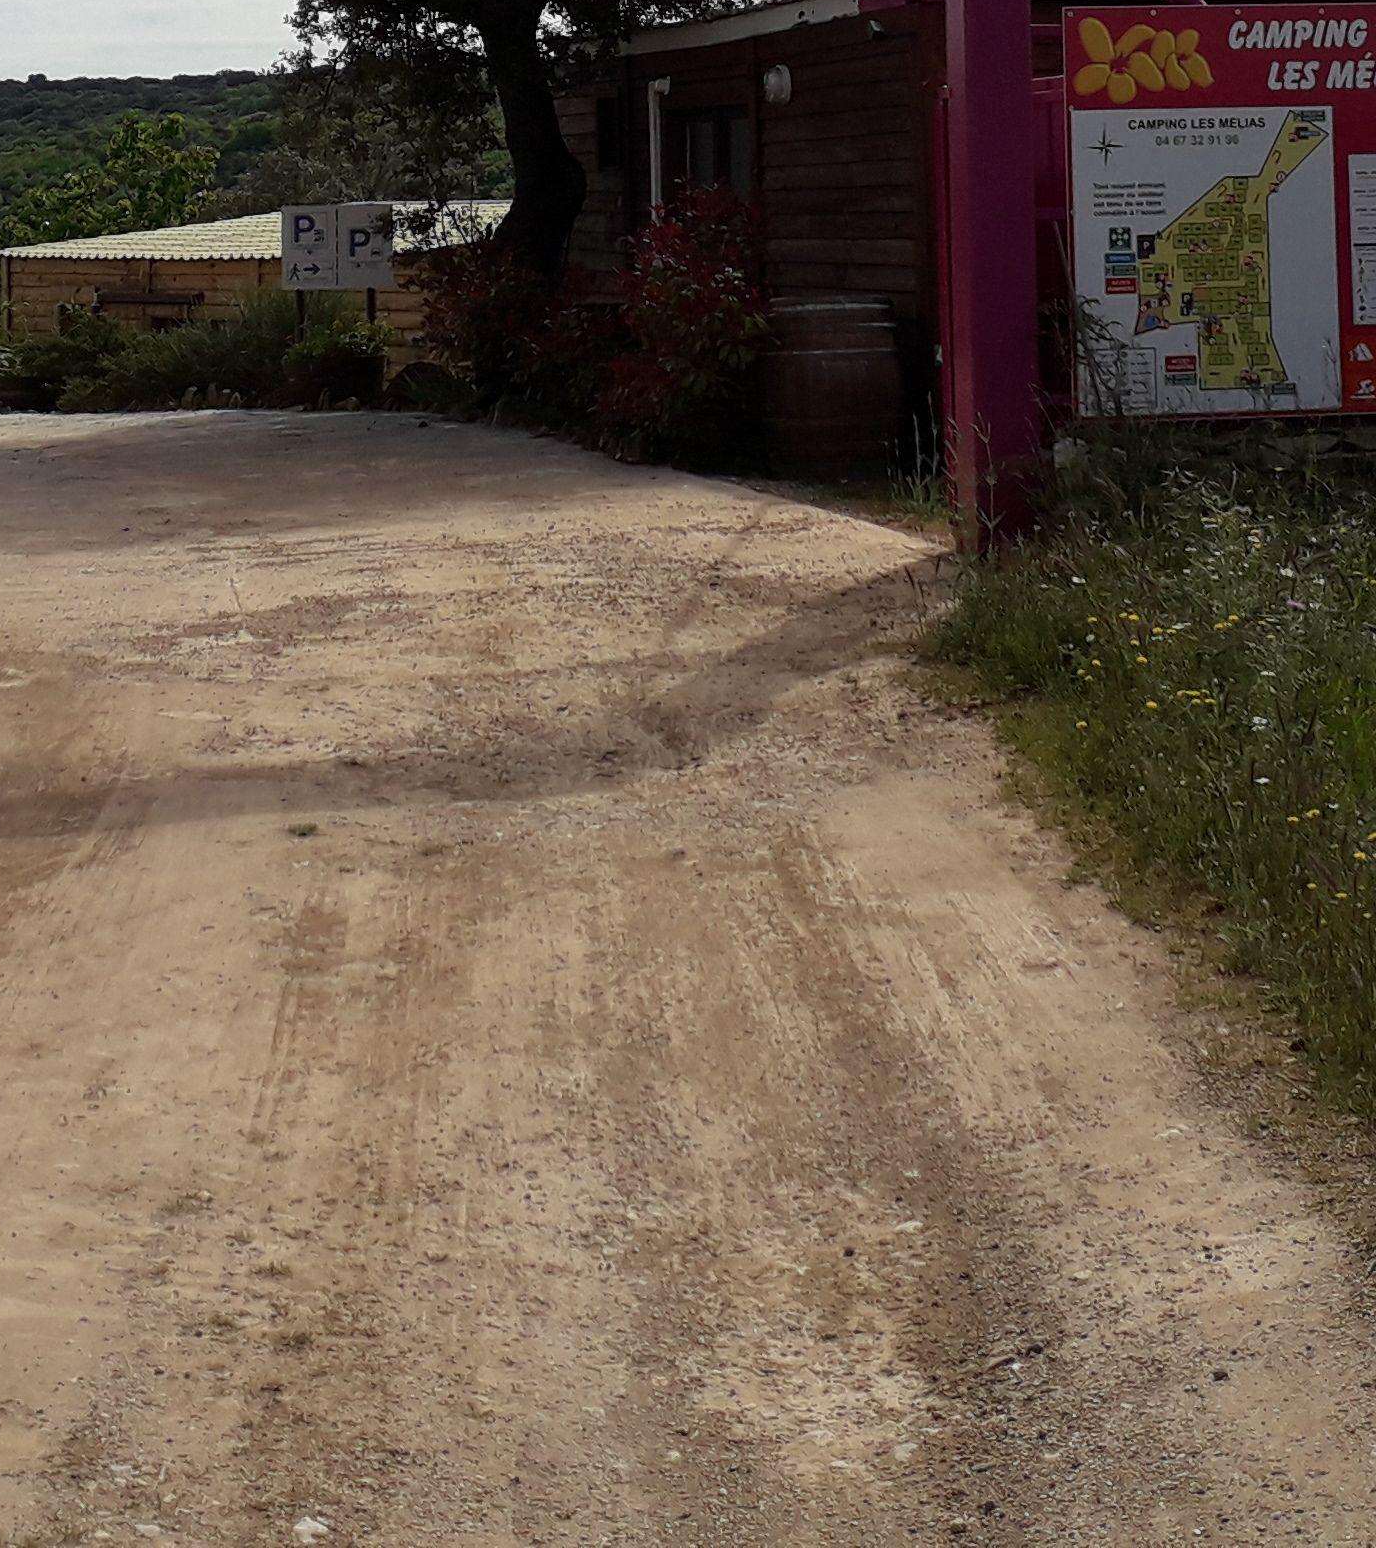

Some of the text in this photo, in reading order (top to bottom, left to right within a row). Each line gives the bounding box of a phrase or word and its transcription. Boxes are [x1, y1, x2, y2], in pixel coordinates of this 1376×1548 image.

[1228, 18, 1368, 49] CAMPING
[1267, 60, 1320, 90] LES
[1128, 117, 1266, 130] CAMPING LES MELIAS
[294, 215, 315, 243] P
[349, 228, 371, 257] P
